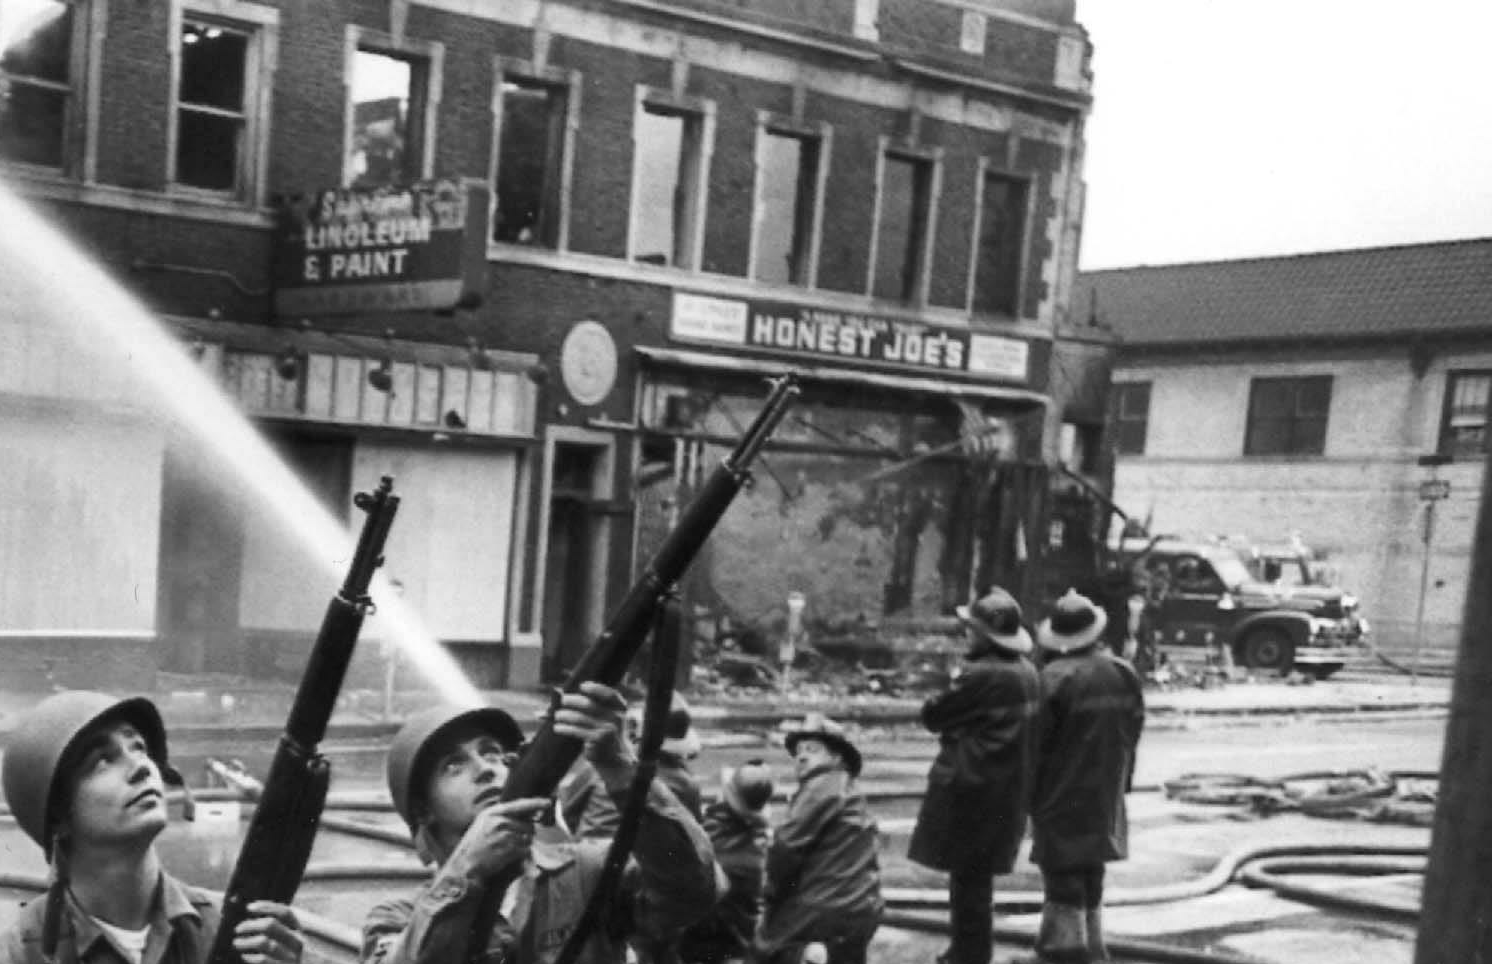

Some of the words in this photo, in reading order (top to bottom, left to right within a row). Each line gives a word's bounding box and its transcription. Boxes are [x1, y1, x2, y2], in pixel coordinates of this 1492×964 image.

[305, 217, 431, 248] LINOLEUM
[330, 249, 409, 279] PAINT
[753, 315, 876, 356] HONEST
[883, 332, 963, 368] JOE'S
